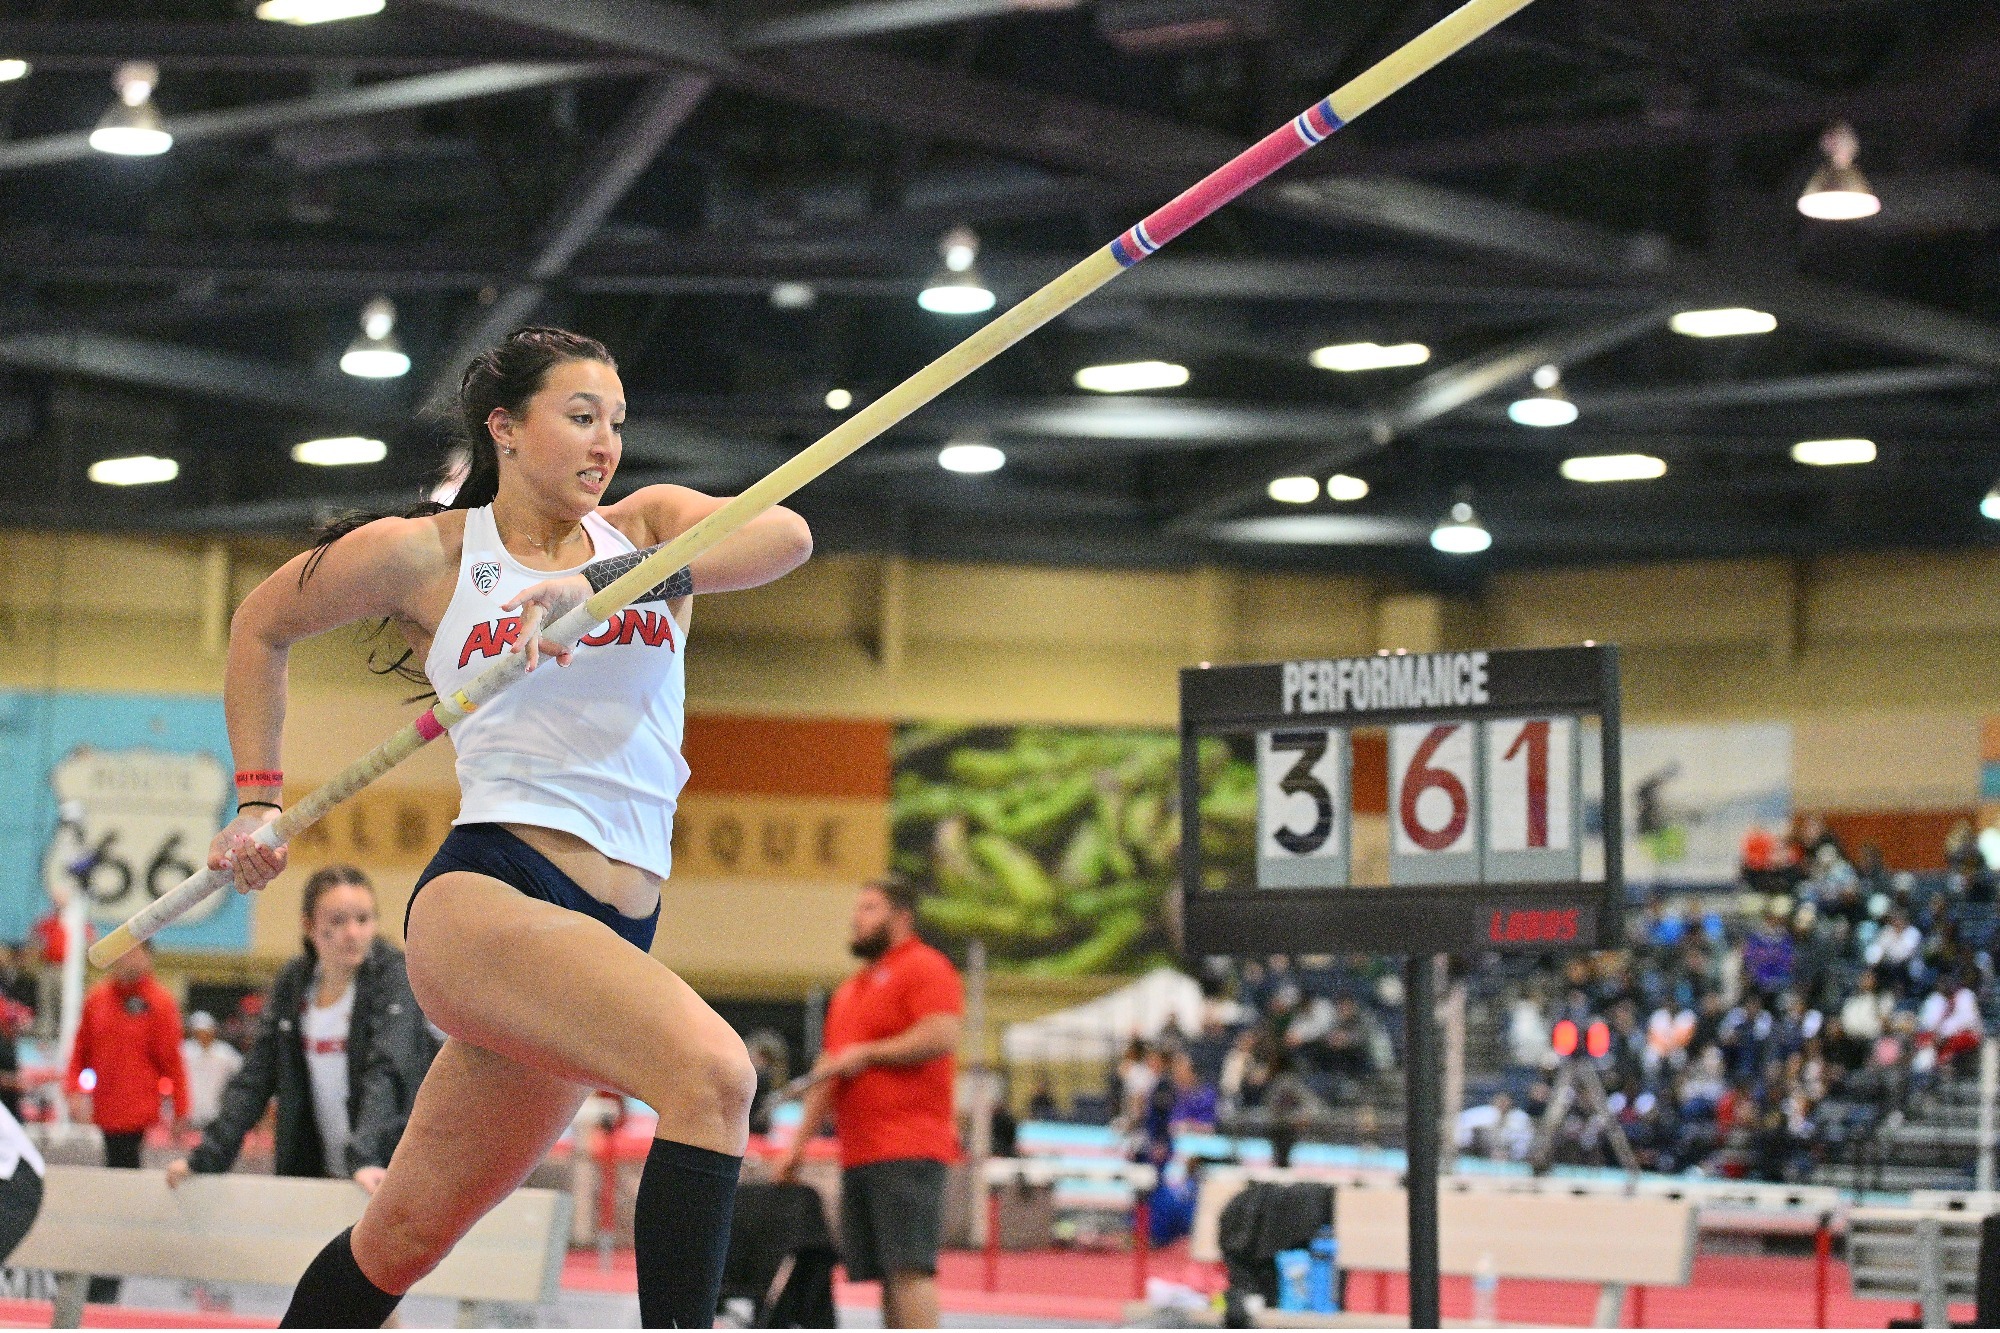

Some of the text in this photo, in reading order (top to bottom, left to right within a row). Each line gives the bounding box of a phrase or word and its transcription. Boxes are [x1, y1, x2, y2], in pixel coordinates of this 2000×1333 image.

[481, 579, 492, 589] 12
[458, 608, 675, 669] ARONA
[1282, 653, 1489, 713] PERFORMANCE
